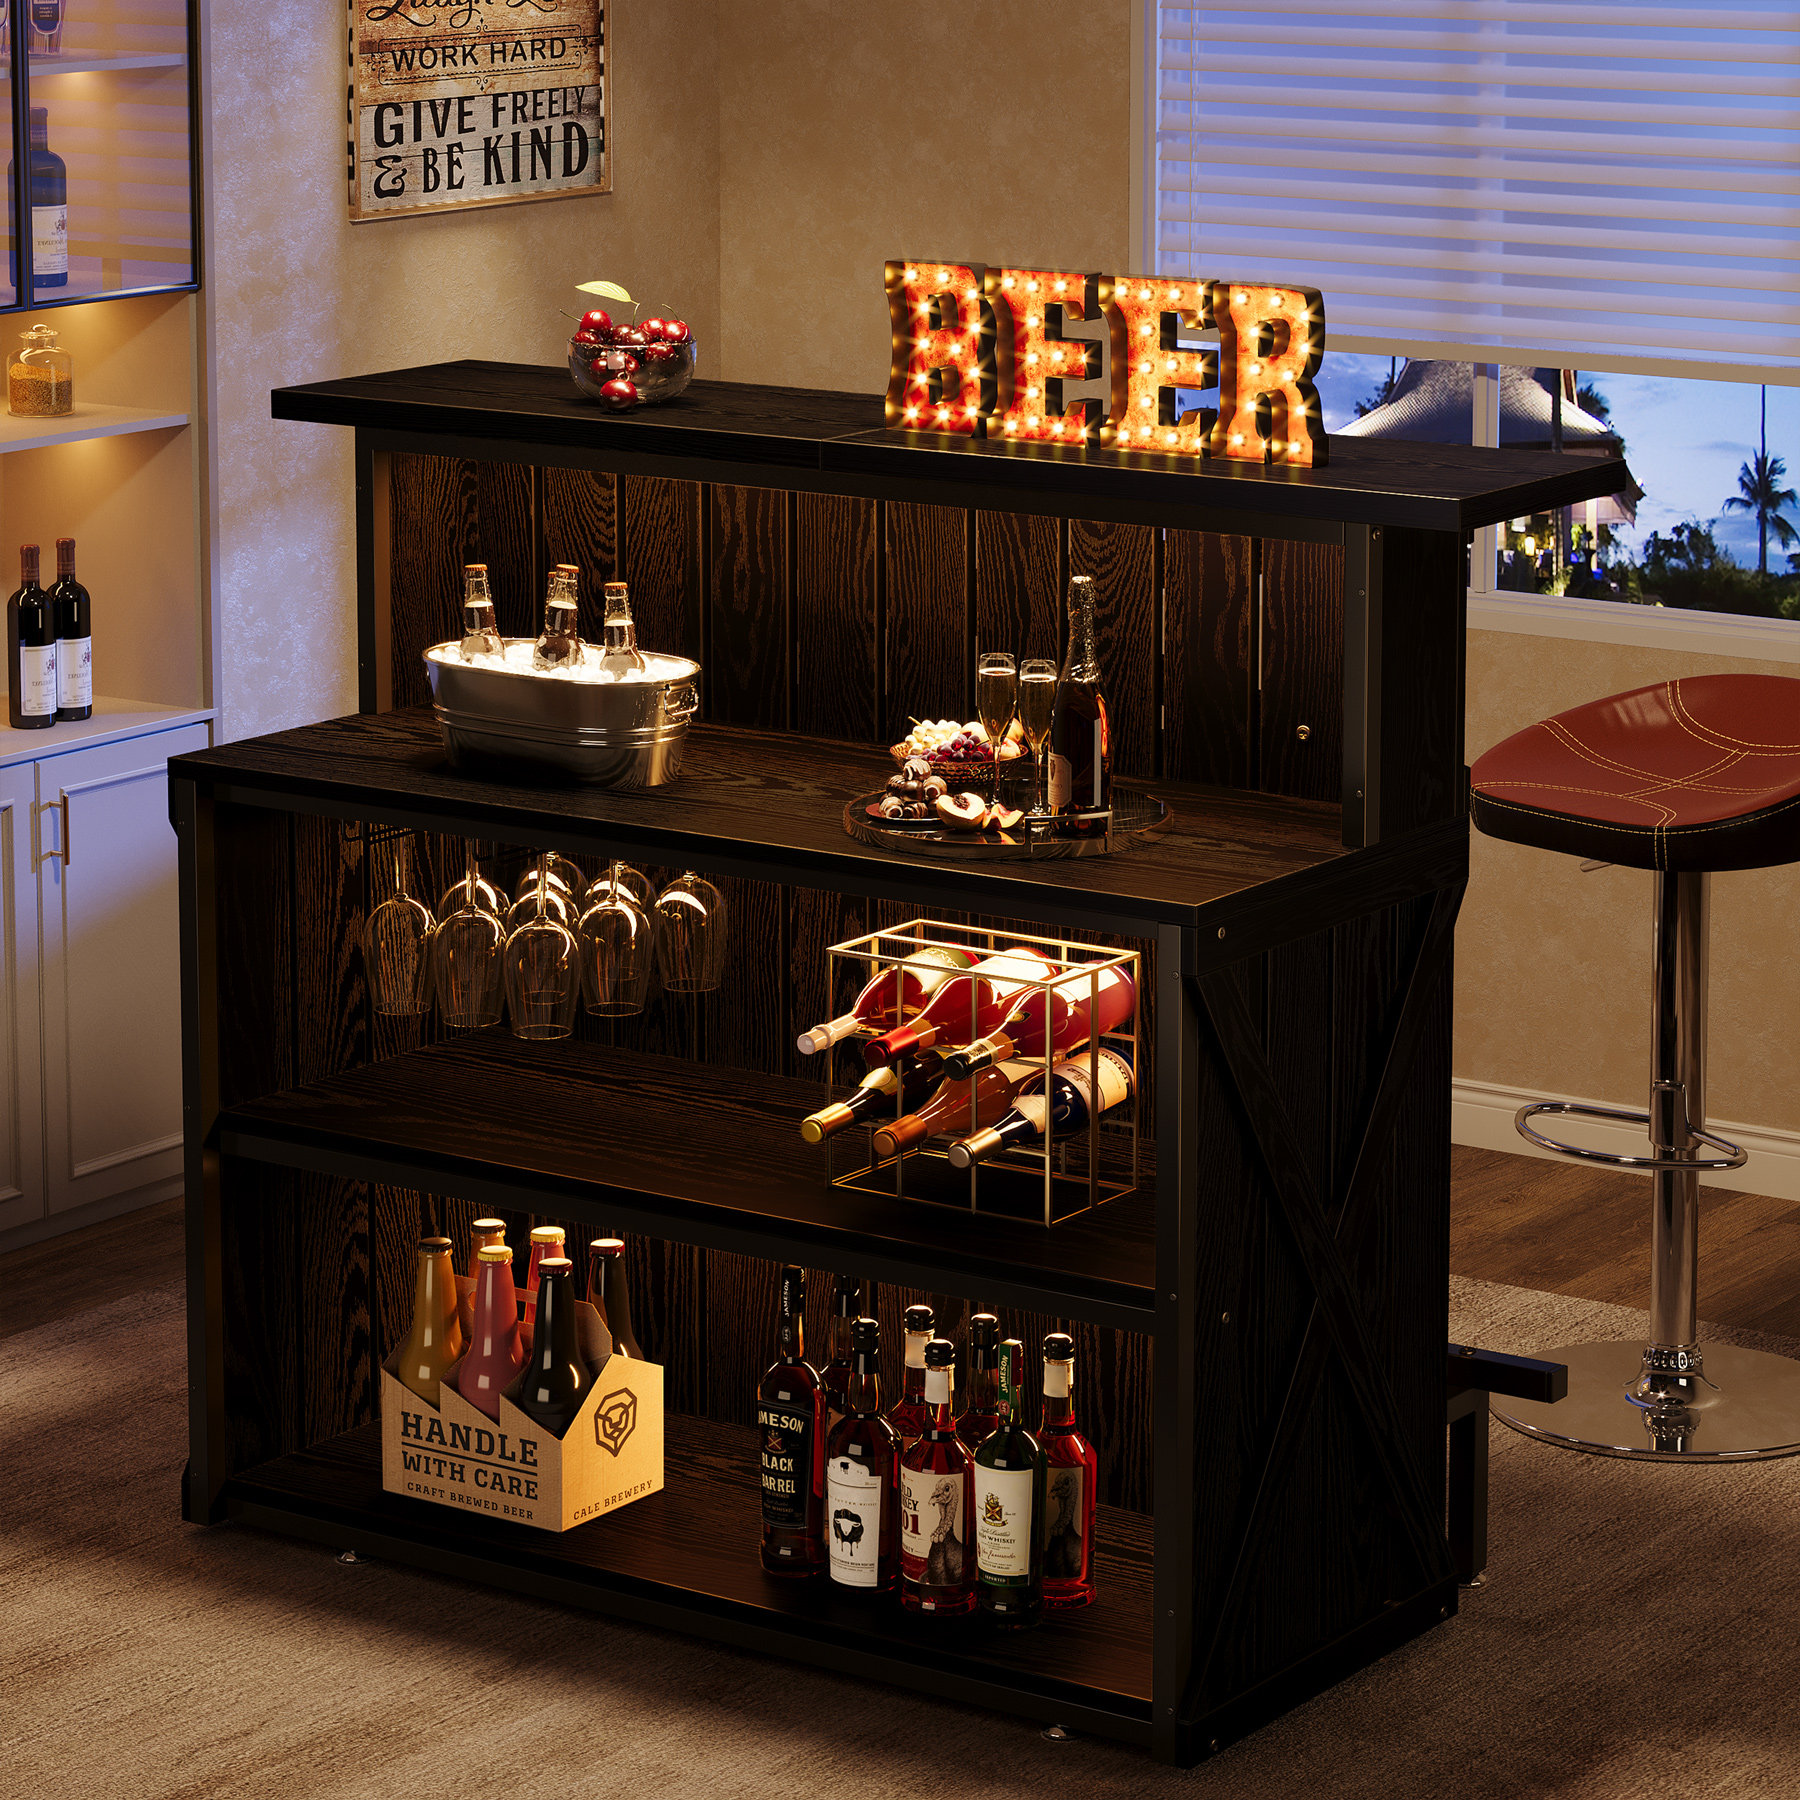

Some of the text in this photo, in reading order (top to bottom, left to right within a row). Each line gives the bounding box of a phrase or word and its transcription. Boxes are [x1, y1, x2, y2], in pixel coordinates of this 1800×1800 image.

[391, 37, 567, 72] WORK HARD
[373, 85, 586, 148] GIVE FREELY
[373, 121, 590, 199] & BE KIND
[884, 260, 1329, 469] BEER
[1000, 1354, 1009, 1394] JAMESON
[401, 1411, 538, 1467] HANDLE
[402, 1450, 539, 1501] WITH CARE
[407, 1482, 534, 1520] CRAFT BREWED BEER
[573, 1479, 654, 1521] CALE BREWERY
